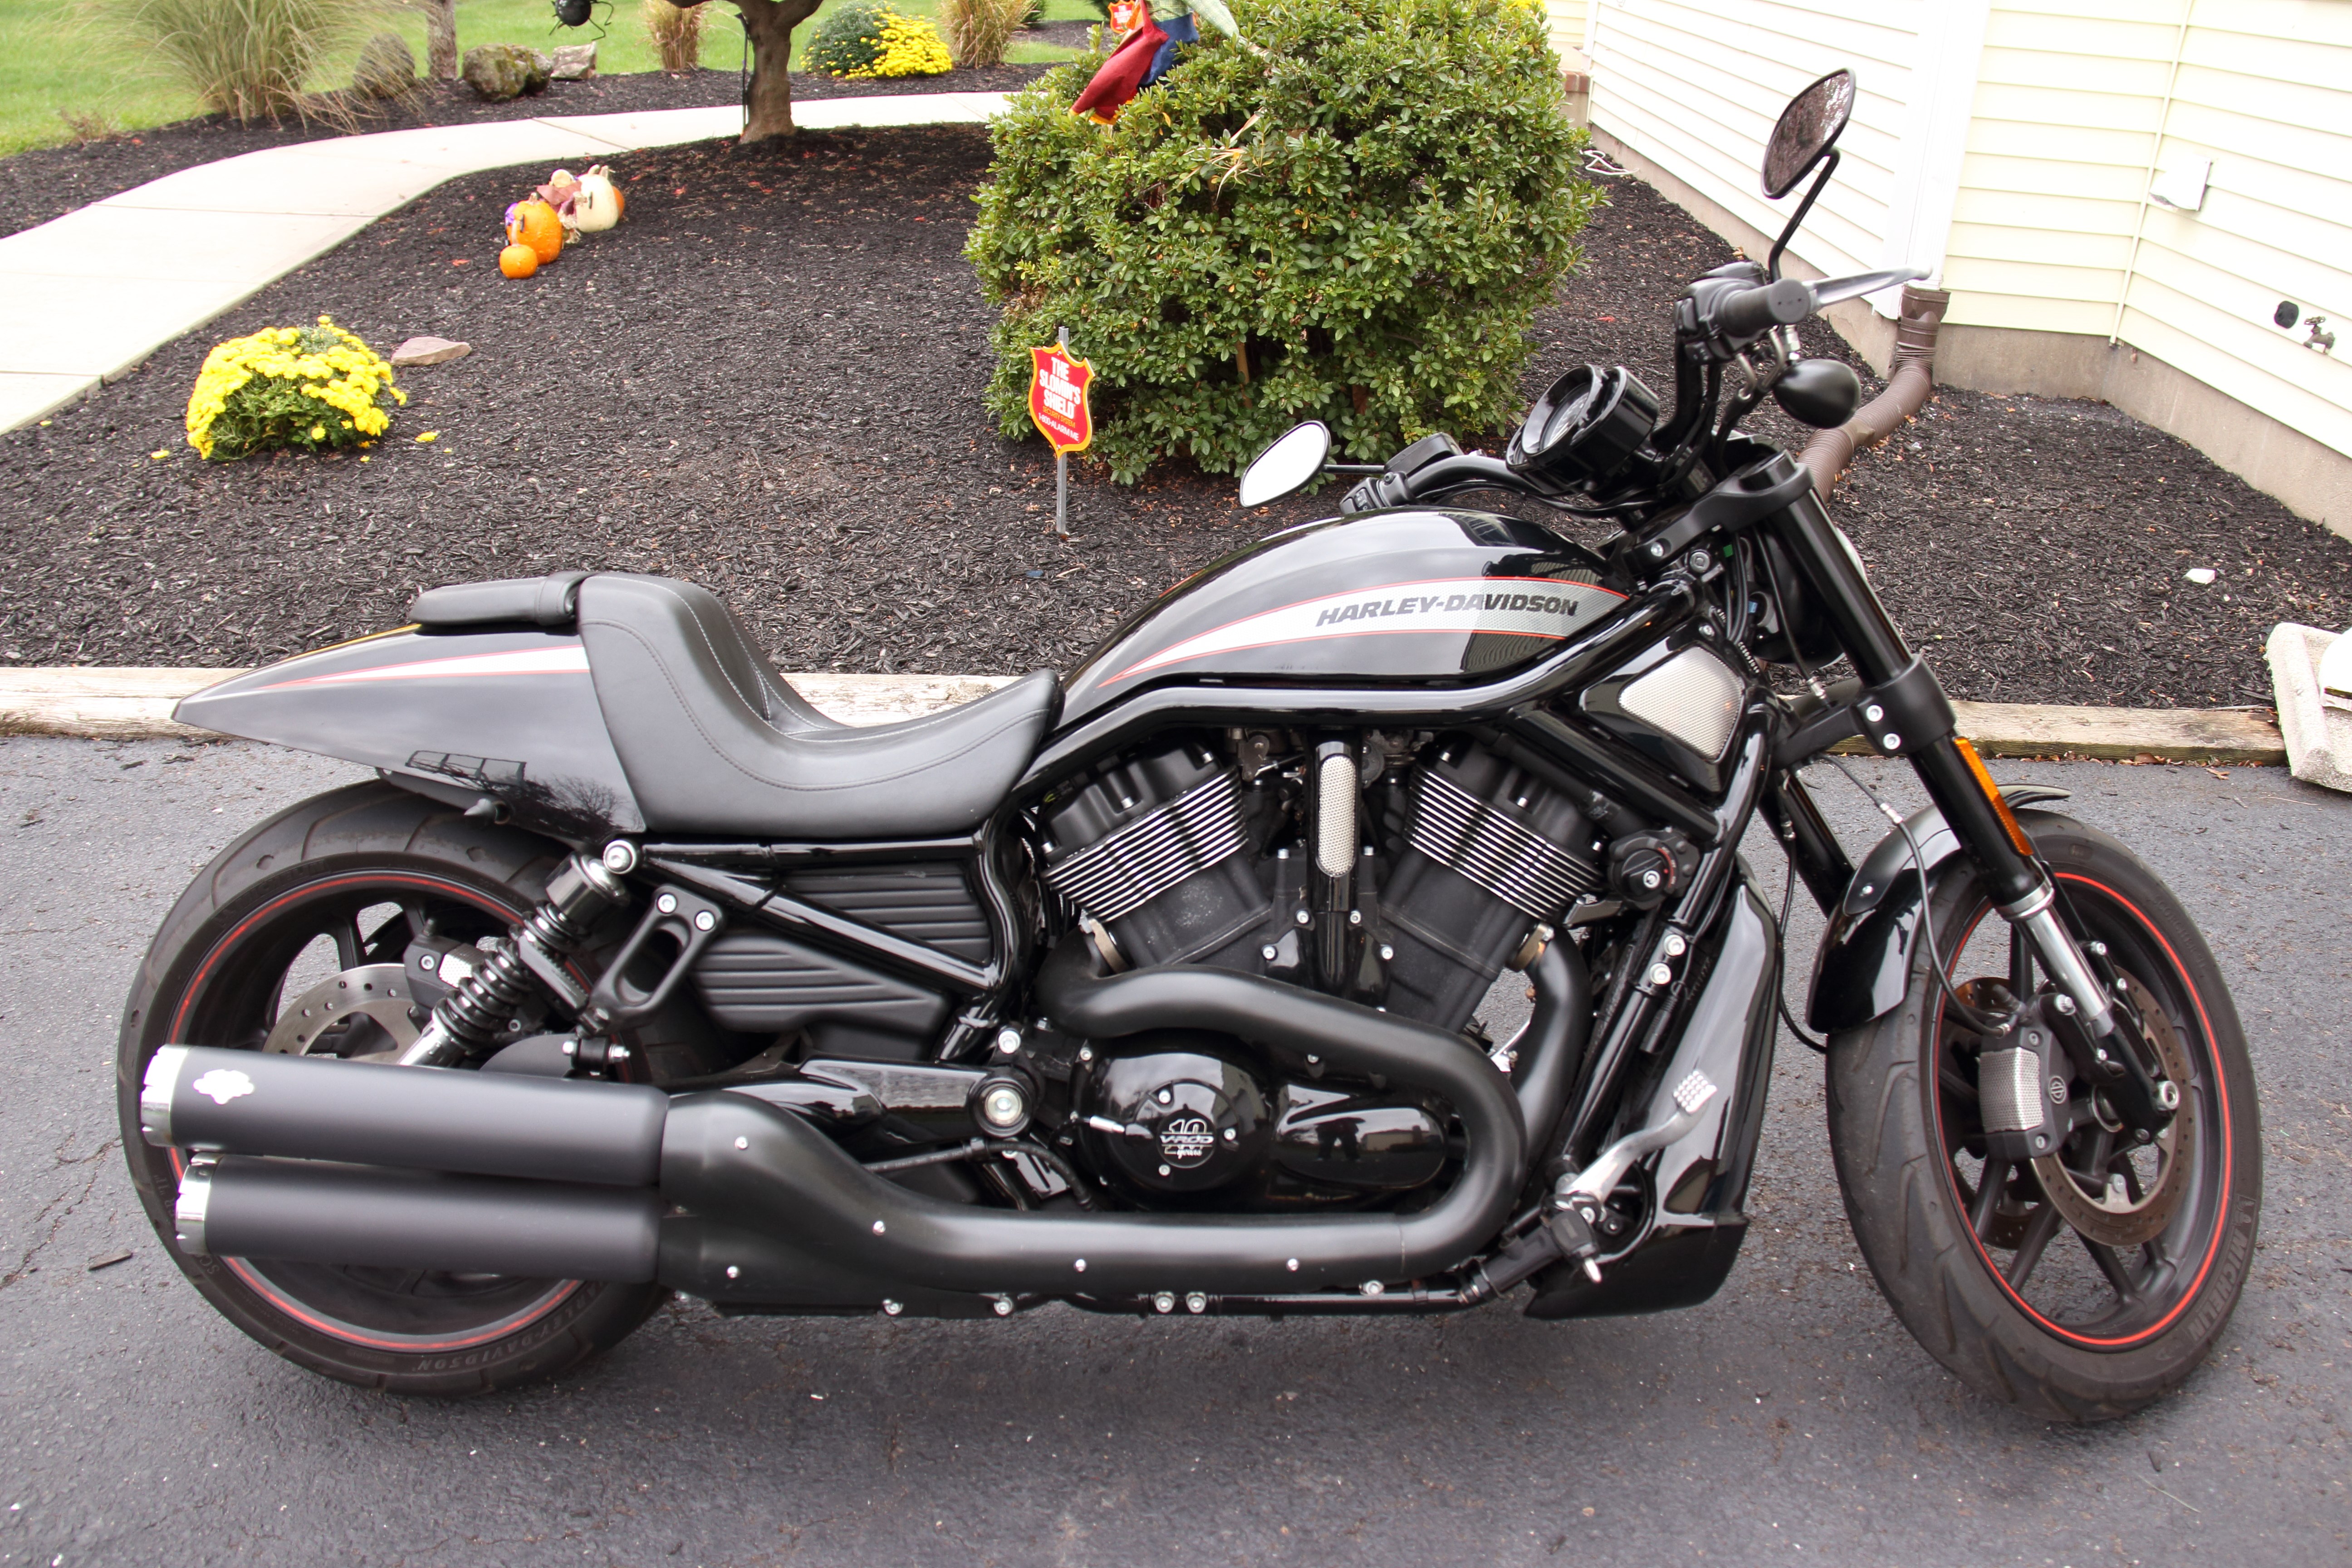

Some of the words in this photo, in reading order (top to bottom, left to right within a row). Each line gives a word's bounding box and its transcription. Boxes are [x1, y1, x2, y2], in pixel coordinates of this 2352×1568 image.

[1051, 357, 1069, 381] THE
[1039, 368, 1081, 405] SLOMIN'S
[1043, 406, 1060, 420] SECURITY
[1060, 415, 1075, 428] SYSTEM
[1044, 390, 1074, 419] SHIELD
[1315, 594, 1578, 627] HARLEY-DAVIDSON
[2187, 1228, 2248, 1341] MICHELIN
[416, 1281, 601, 1371] ARLEY-DAVIDSON
